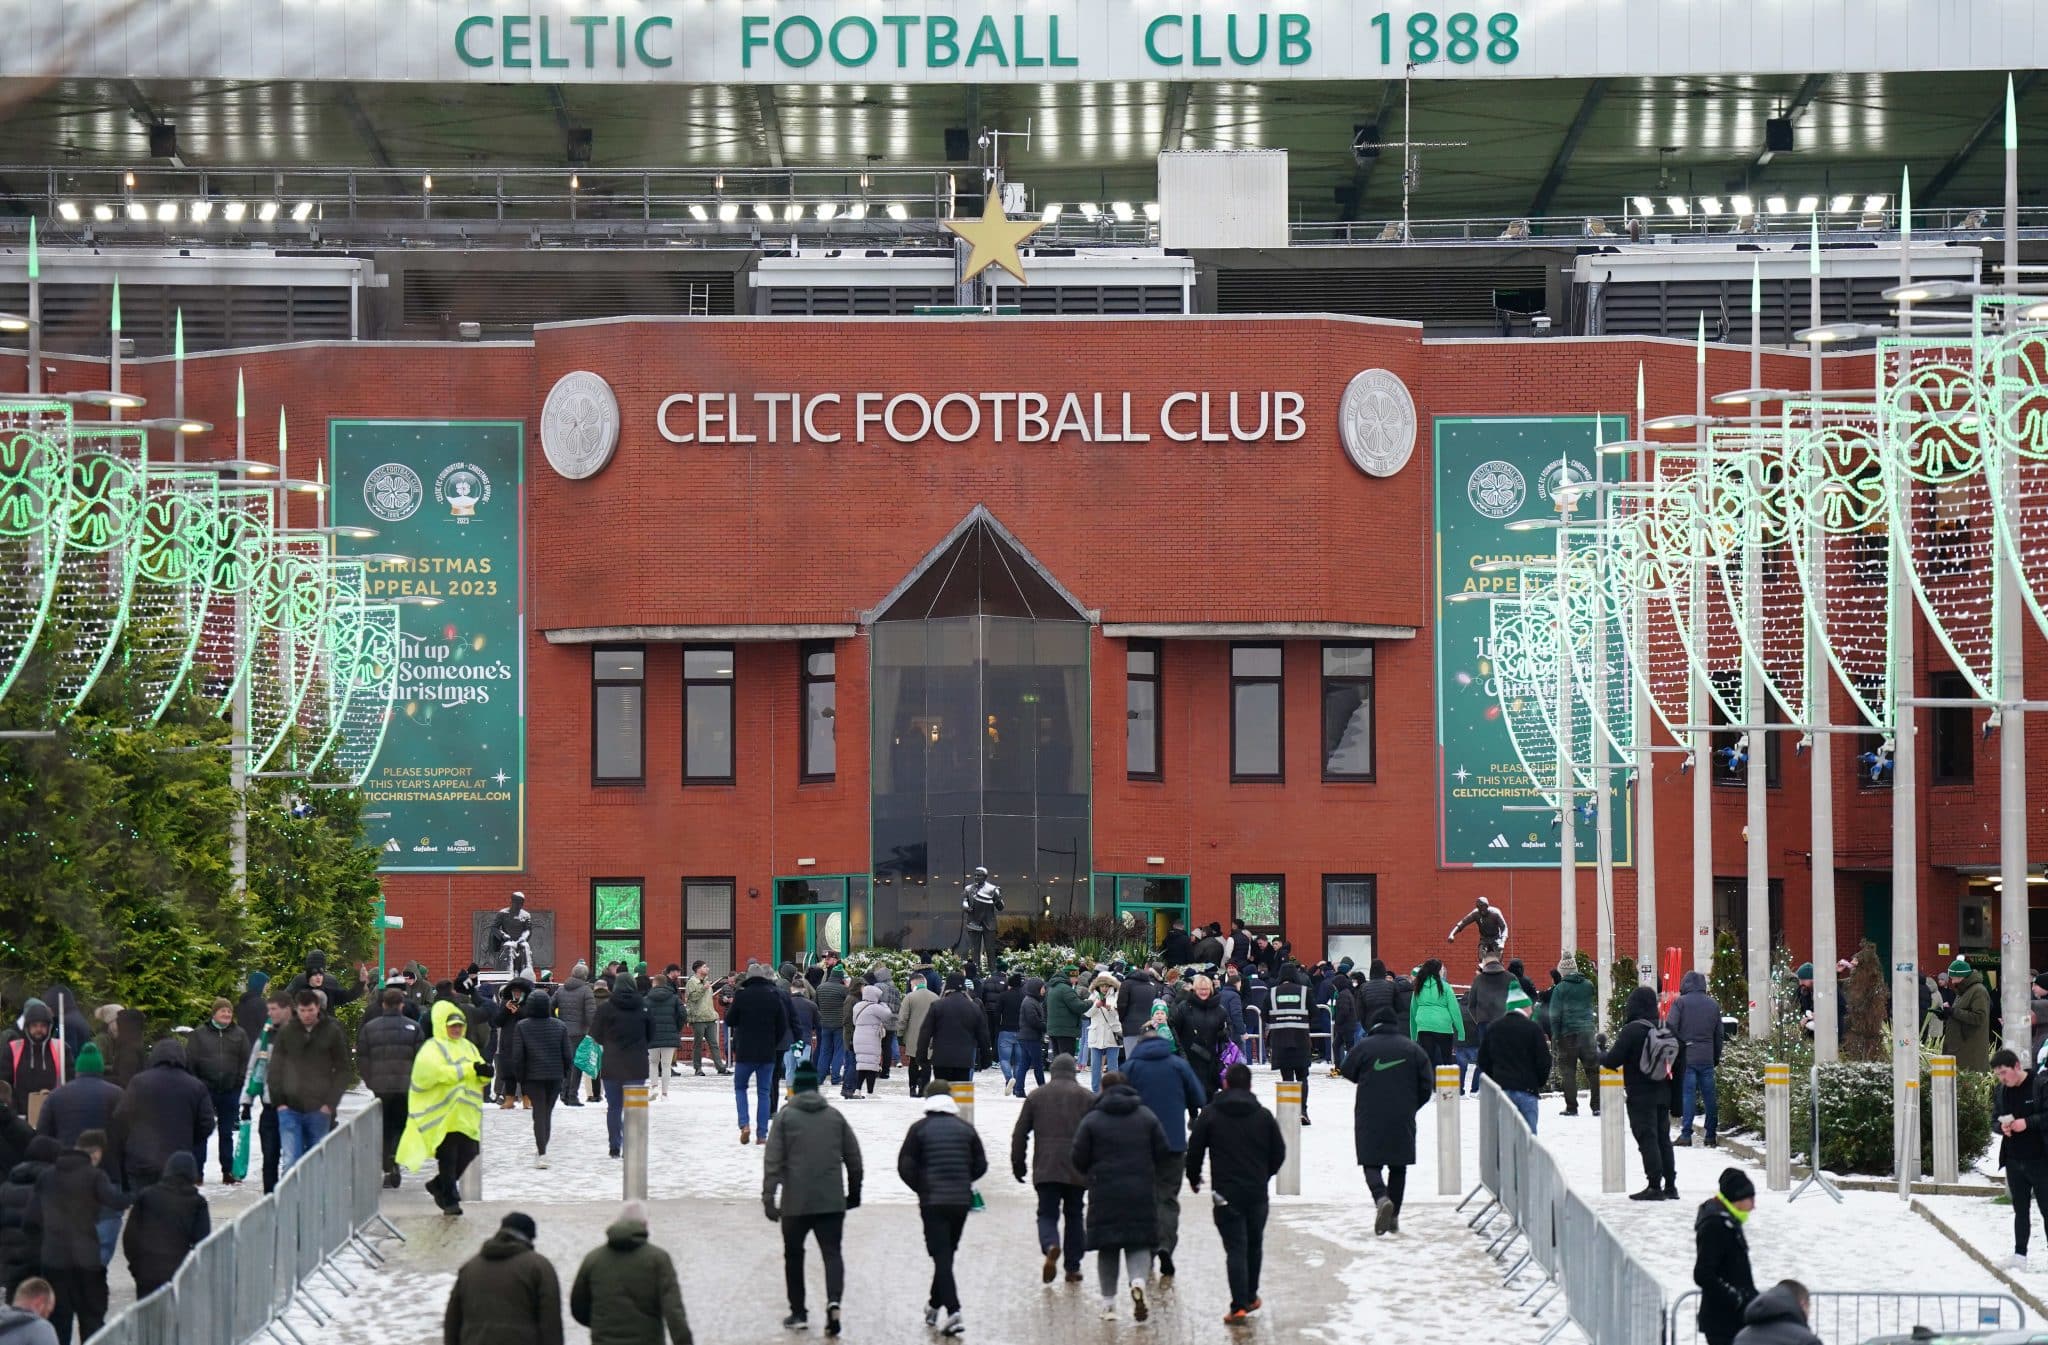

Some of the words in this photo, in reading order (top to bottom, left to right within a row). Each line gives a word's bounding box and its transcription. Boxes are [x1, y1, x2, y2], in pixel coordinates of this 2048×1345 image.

[454, 15, 673, 68] CELTIC
[741, 15, 1079, 68] FOOTBALL
[1144, 13, 1313, 67] CLUB
[1370, 12, 1520, 65] 1888
[656, 393, 841, 443] CELTIC
[856, 392, 1151, 442] FOOTBALL
[1160, 391, 1306, 442] CLUB
[364, 558, 492, 573] CHRISTMAS
[363, 580, 442, 595] APPEAL
[448, 580, 497, 596] 2023
[424, 644, 450, 662] up
[379, 682, 490, 707] Christmas
[383, 768, 422, 776] PLEASE
[424, 768, 473, 776] SUPPORT
[369, 779, 393, 789] THIS
[395, 779, 430, 789] YEAR'S
[433, 780, 473, 789] APPEAL
[474, 780, 487, 789] AT
[1477, 776, 1500, 785] THIS
[1502, 776, 1532, 785] YEAR
[359, 792, 511, 801] TICCHRISTMASAPPEAL.COM
